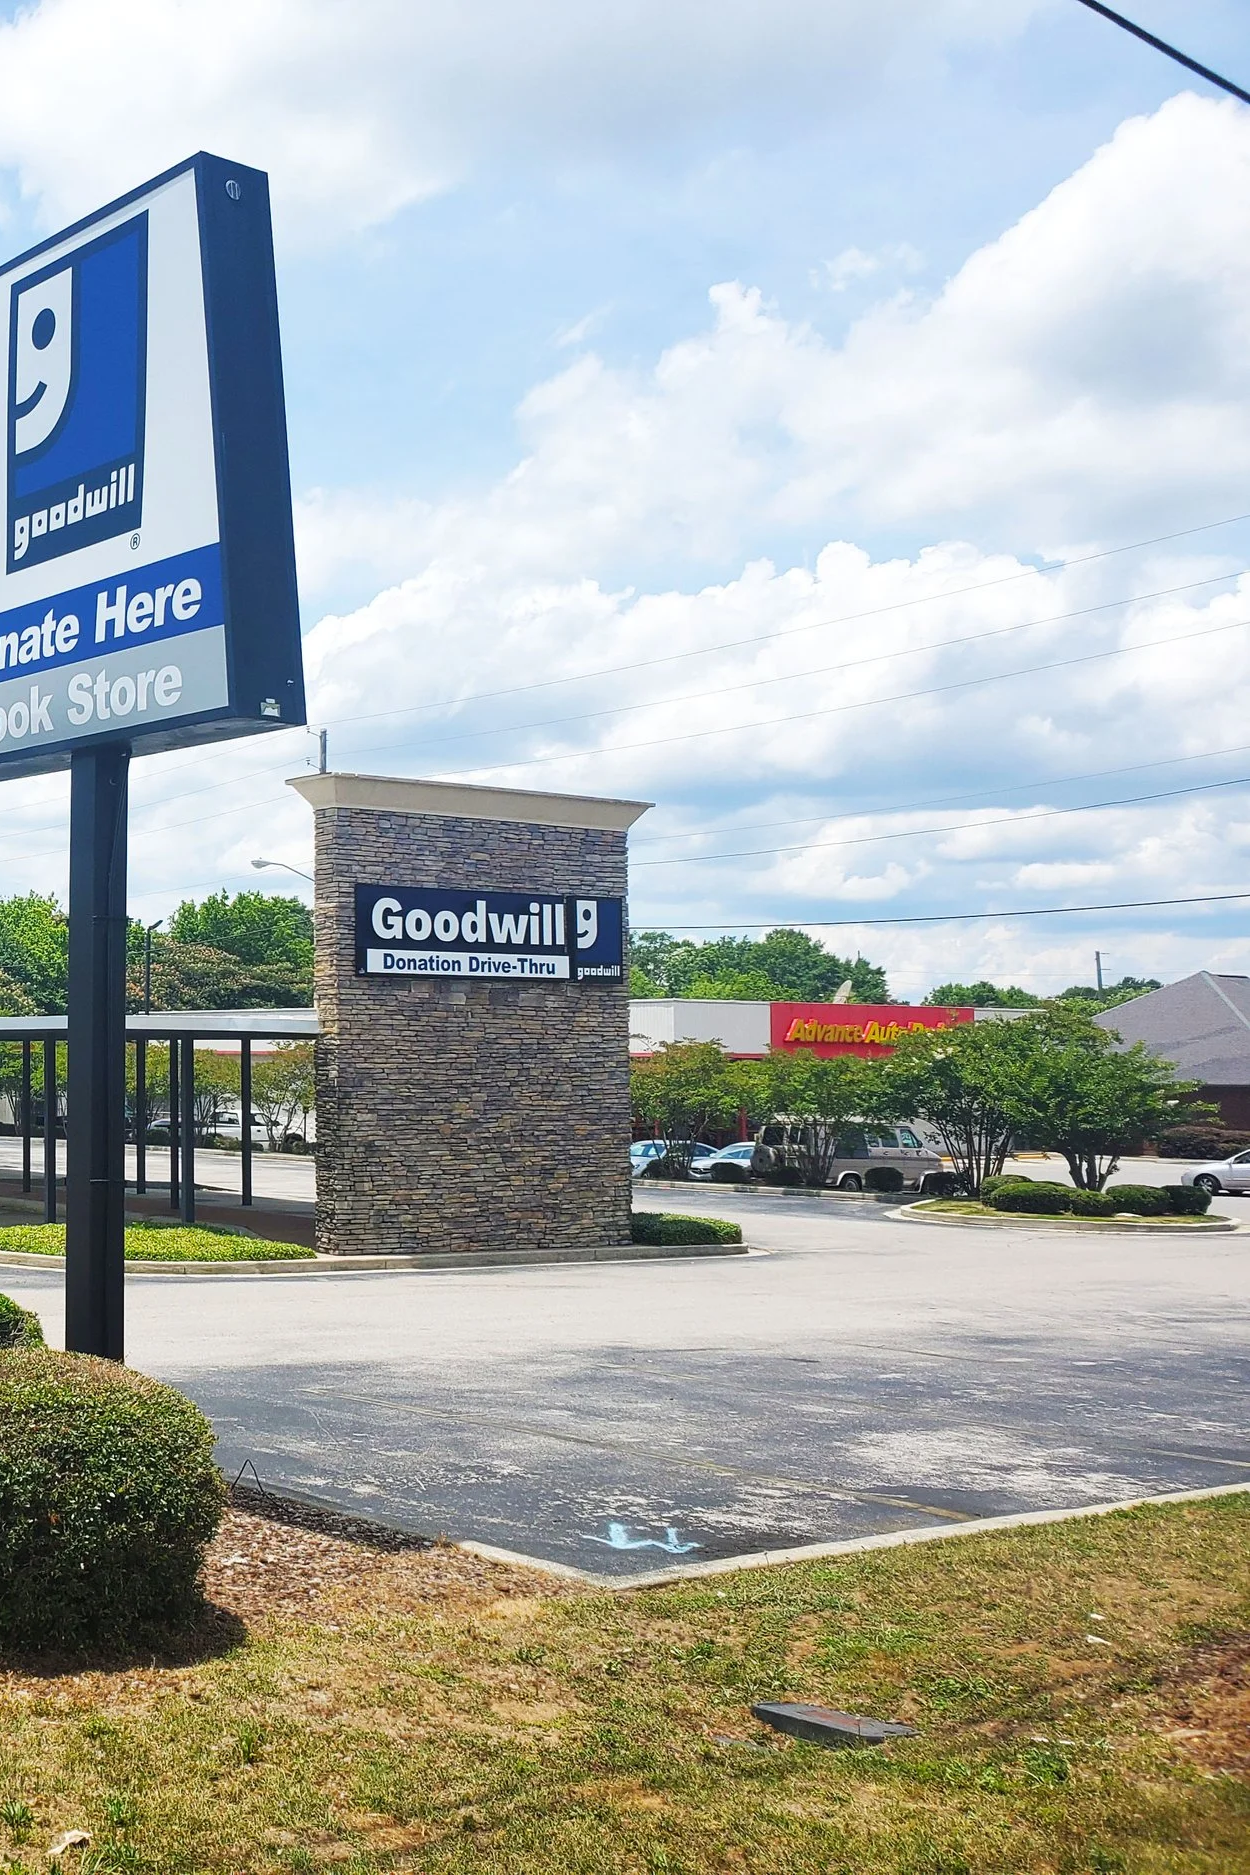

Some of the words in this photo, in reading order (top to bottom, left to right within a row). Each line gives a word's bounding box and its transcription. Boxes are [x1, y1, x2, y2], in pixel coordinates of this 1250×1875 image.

[14, 463, 135, 561] goodwill
[95, 578, 202, 644] Here
[67, 664, 183, 726] Store
[371, 897, 565, 946] Goodwill
[382, 952, 463, 974] Donation
[468, 956, 556, 975] Drive-Thru
[577, 965, 621, 980] goodwill
[784, 1018, 864, 1043] Advance
